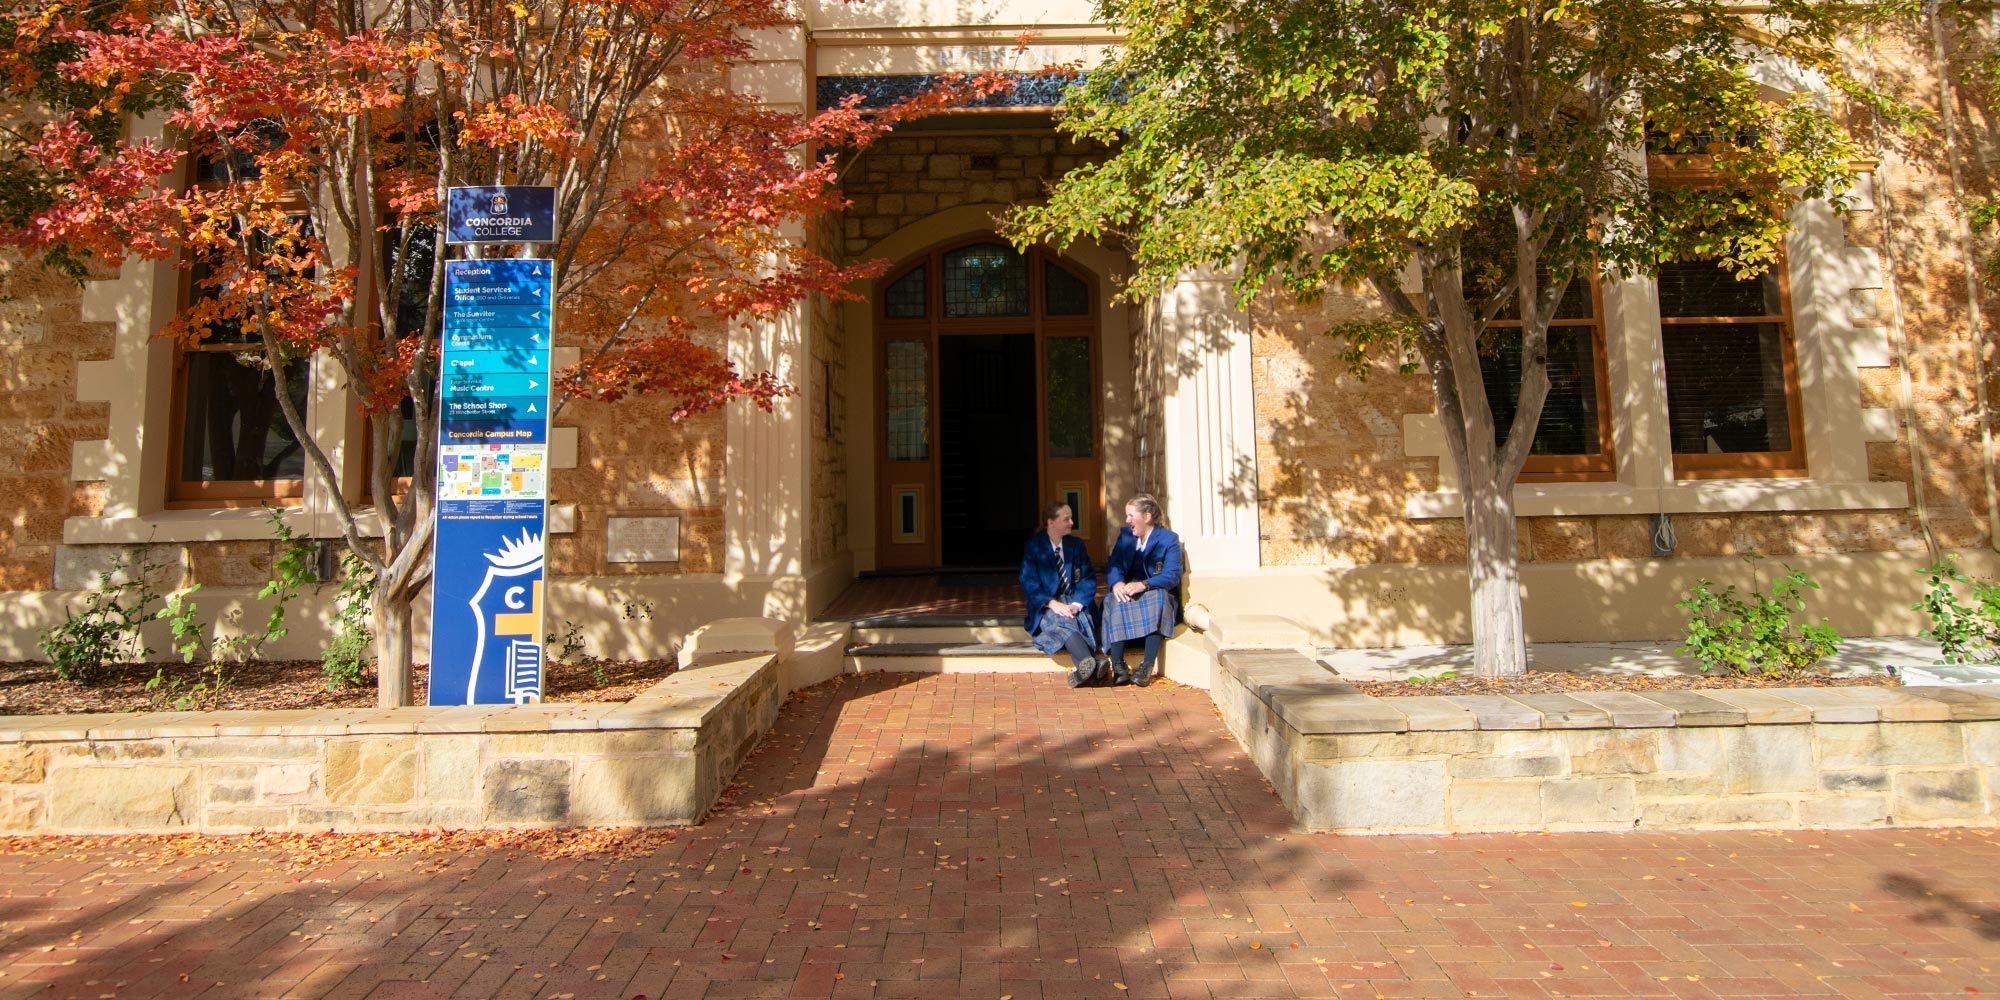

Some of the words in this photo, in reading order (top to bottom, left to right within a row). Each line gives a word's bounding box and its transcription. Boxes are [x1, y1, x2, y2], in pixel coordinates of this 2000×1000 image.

[940, 50, 1055, 67] RECEPTON
[465, 217, 533, 227] CONCORDIA
[474, 227, 522, 236] COLLEGE
[455, 268, 491, 277] Reception
[454, 287, 481, 295] Student
[482, 286, 512, 294] Services
[450, 359, 475, 367] Chapel
[488, 401, 508, 410] Shop
[448, 430, 484, 438] Concordia
[484, 430, 515, 439] Campus
[515, 429, 533, 438] Map
[504, 585, 526, 610] C
